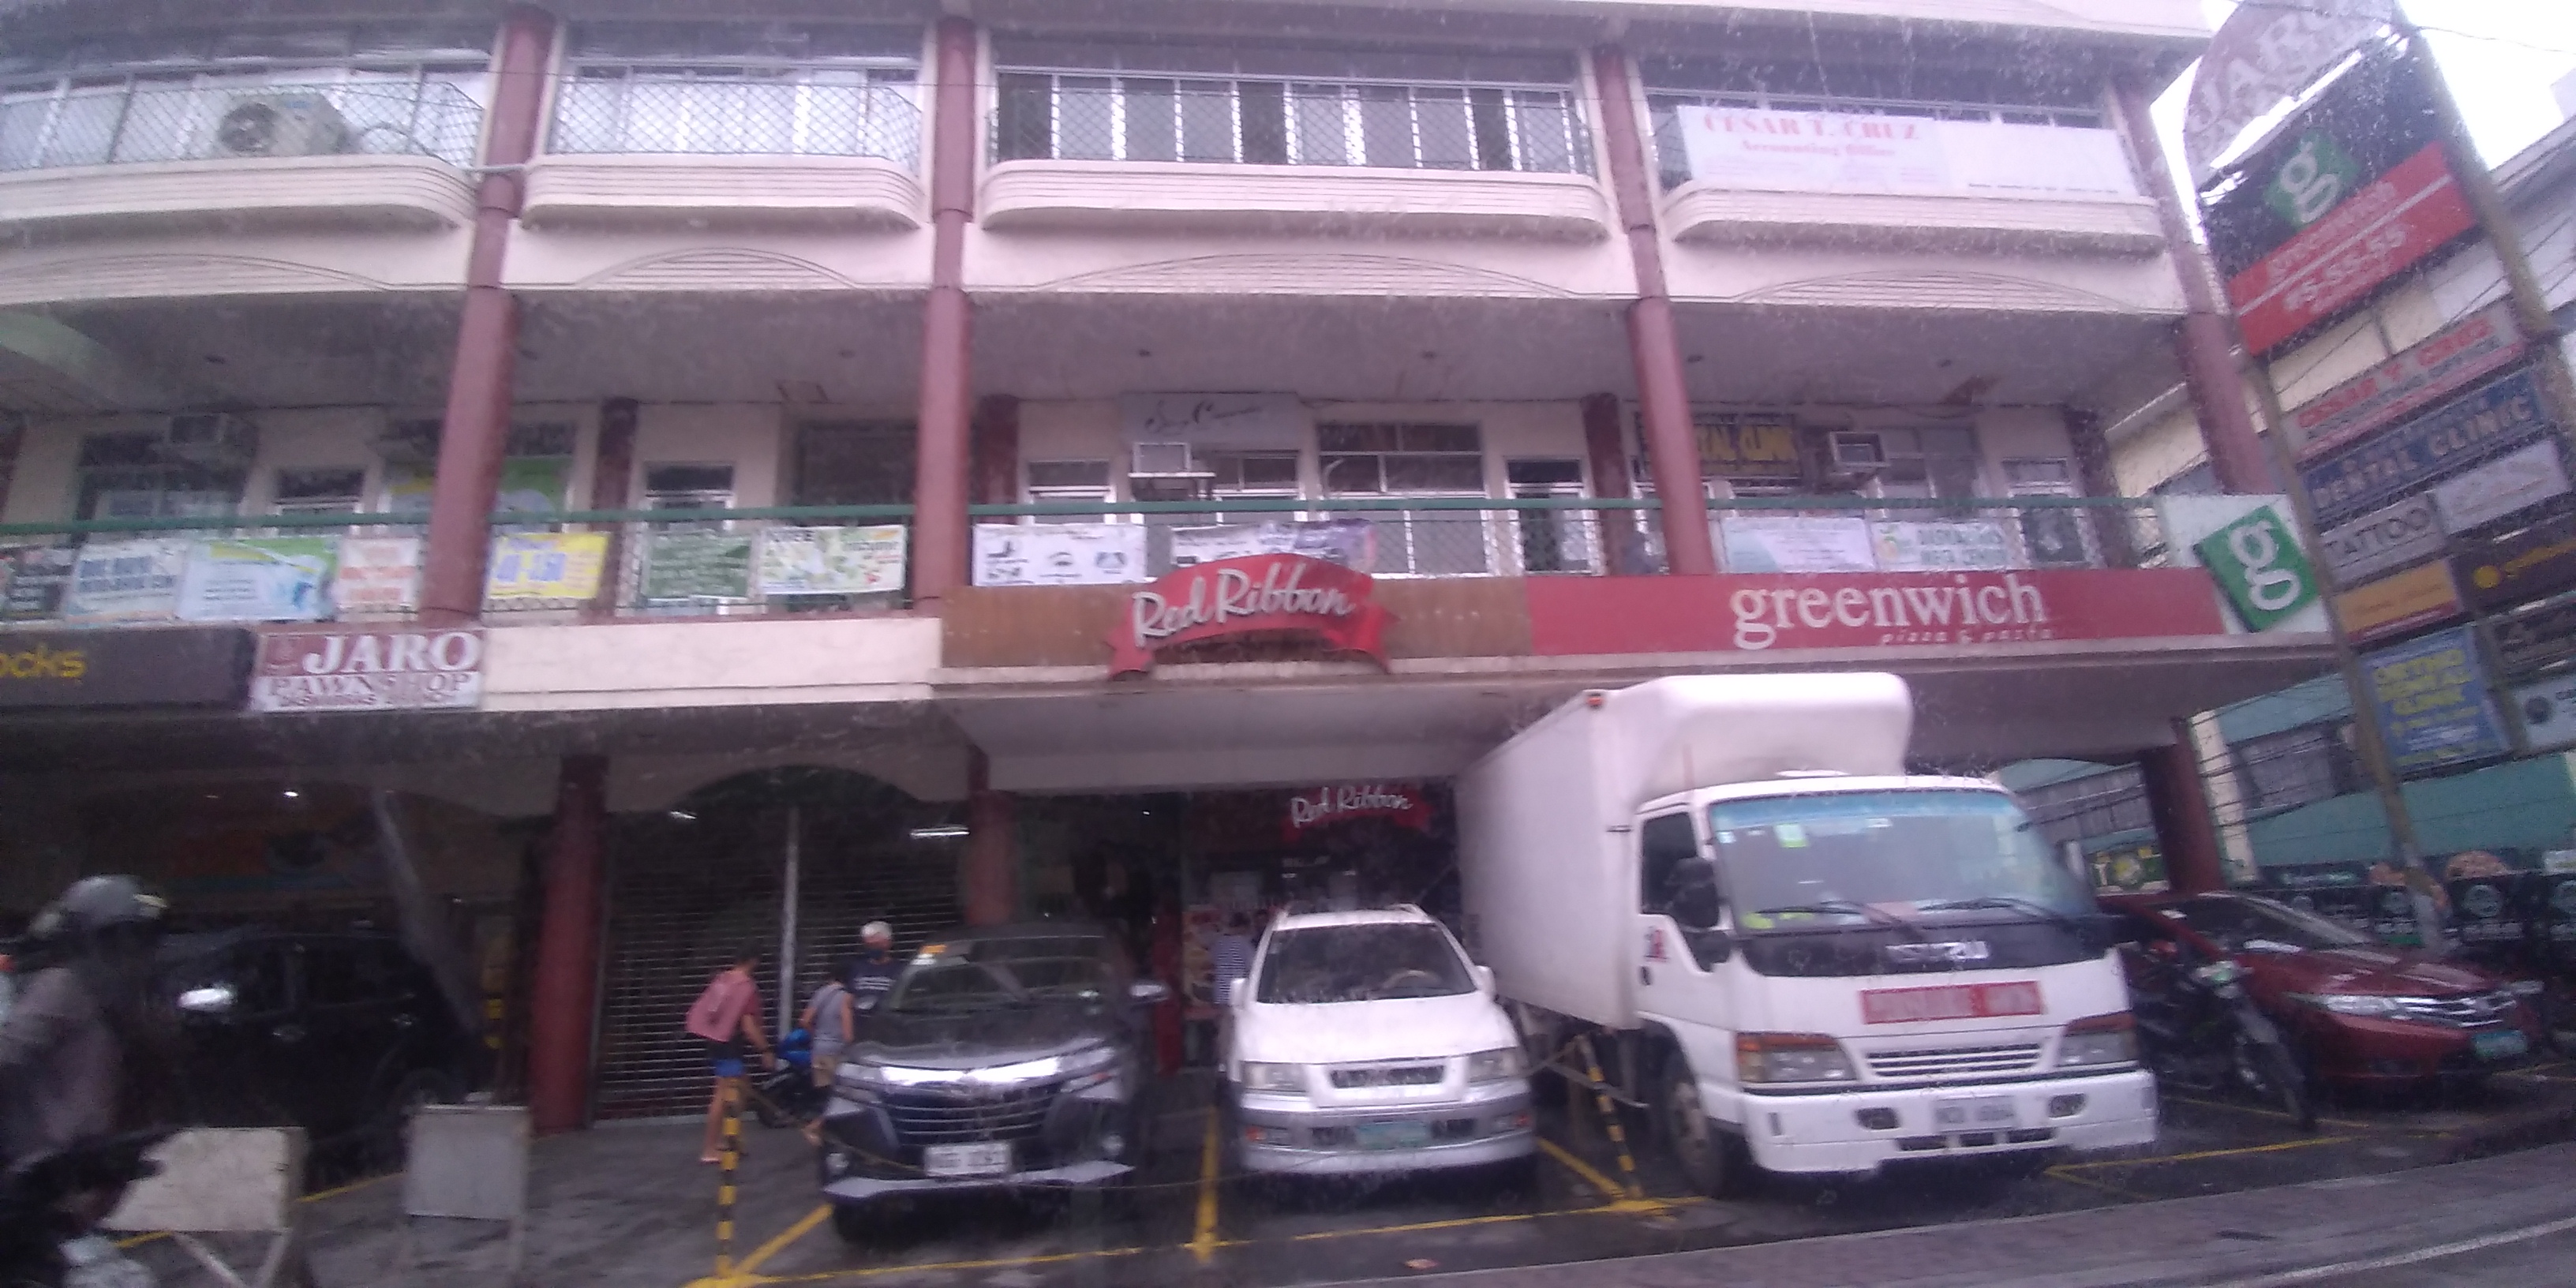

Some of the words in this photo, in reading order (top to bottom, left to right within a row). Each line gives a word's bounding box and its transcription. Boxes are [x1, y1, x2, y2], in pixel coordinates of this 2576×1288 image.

[1704, 114, 1801, 135] CESAR
[1844, 119, 1920, 140] CRUZ
[2312, 447, 2421, 511] DENTAL
[2430, 395, 2535, 457] CLINIC
[2228, 520, 2301, 611] g
[1133, 578, 1214, 648] Red
[1215, 563, 1356, 627] Ribbon
[1729, 574, 2049, 651] greenwich
[272, 673, 471, 696] PAWNSHOP
[302, 631, 482, 674] JARO
